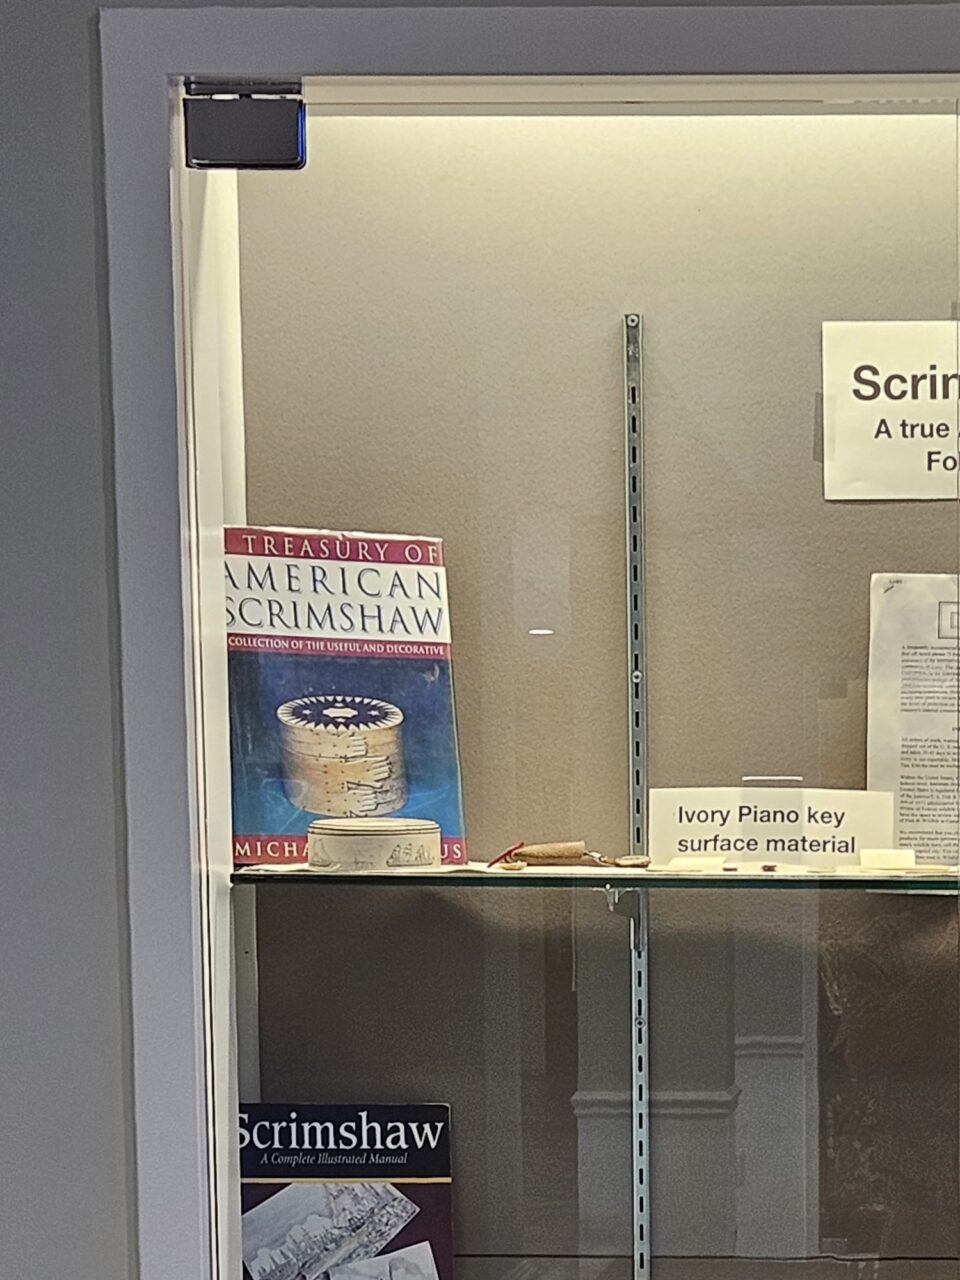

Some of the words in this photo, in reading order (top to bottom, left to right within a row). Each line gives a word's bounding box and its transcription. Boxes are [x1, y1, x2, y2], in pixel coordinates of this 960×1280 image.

[874, 418, 892, 439] A
[900, 418, 950, 438] true
[243, 534, 388, 562] TREASURY
[405, 543, 440, 563] OF
[224, 560, 443, 602] AMERICAN
[226, 595, 443, 636] SCRIMSHAW
[228, 637, 290, 650] COLLECTION
[290, 639, 303, 650] OF
[304, 640, 325, 651] THE
[326, 641, 362, 653] USEFUL
[363, 643, 385, 654] AND
[386, 644, 444, 656] DECORATIVE
[678, 805, 731, 826] Ivory
[738, 804, 800, 825] Piano
[807, 806, 846, 828] key
[235, 840, 308, 858] MICHA
[677, 834, 759, 852] surface
[766, 836, 855, 854] material
[239, 1110, 444, 1151] Scrimshaw
[260, 1153, 269, 1165] A
[271, 1153, 316, 1167] Complete
[317, 1153, 367, 1165] Illustrated
[369, 1153, 408, 1165] Manual
